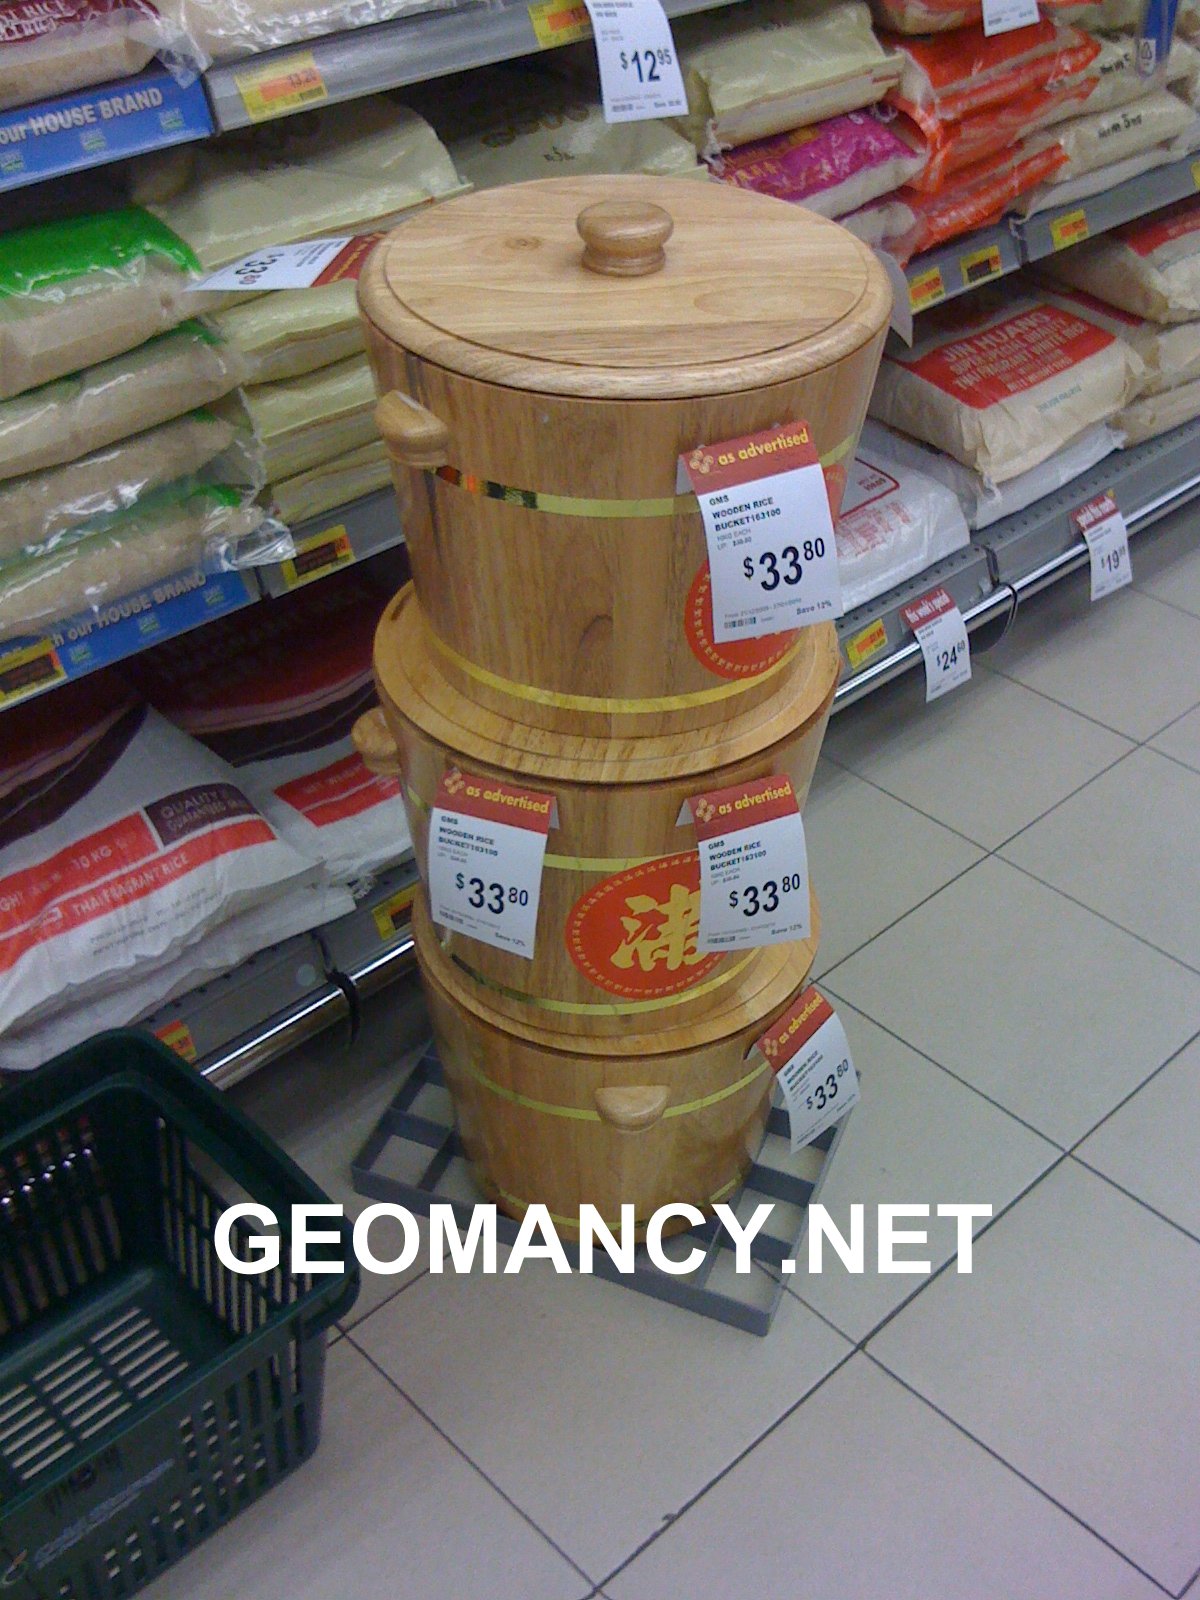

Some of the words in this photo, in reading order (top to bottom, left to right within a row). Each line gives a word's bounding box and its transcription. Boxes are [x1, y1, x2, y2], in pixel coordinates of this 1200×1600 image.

[29, 104, 97, 137] HOUSE
[101, 87, 163, 120] BRAND
[718, 453, 736, 466] as
[738, 427, 809, 460] advertised
[709, 494, 729, 506] GMS
[712, 503, 750, 519] WOODEN
[753, 497, 774, 509] RICE
[796, 605, 815, 616] Save
[68, 621, 94, 641] our
[466, 785, 481, 797] as
[483, 788, 550, 814] advertised
[718, 802, 733, 816] as
[734, 782, 792, 811] advertised
[441, 815, 459, 825] GMS
[439, 826, 474, 841] WOODEN
[476, 834, 495, 846] RICE
[708, 840, 725, 850] GMS
[709, 846, 742, 861] WOODEN
[744, 841, 762, 851] RICE
[72, 894, 101, 917] THAI
[102, 867, 160, 904] FRAGRANT
[161, 852, 189, 876] RICE
[778, 1032, 790, 1044] as
[788, 991, 824, 1034] advertised
